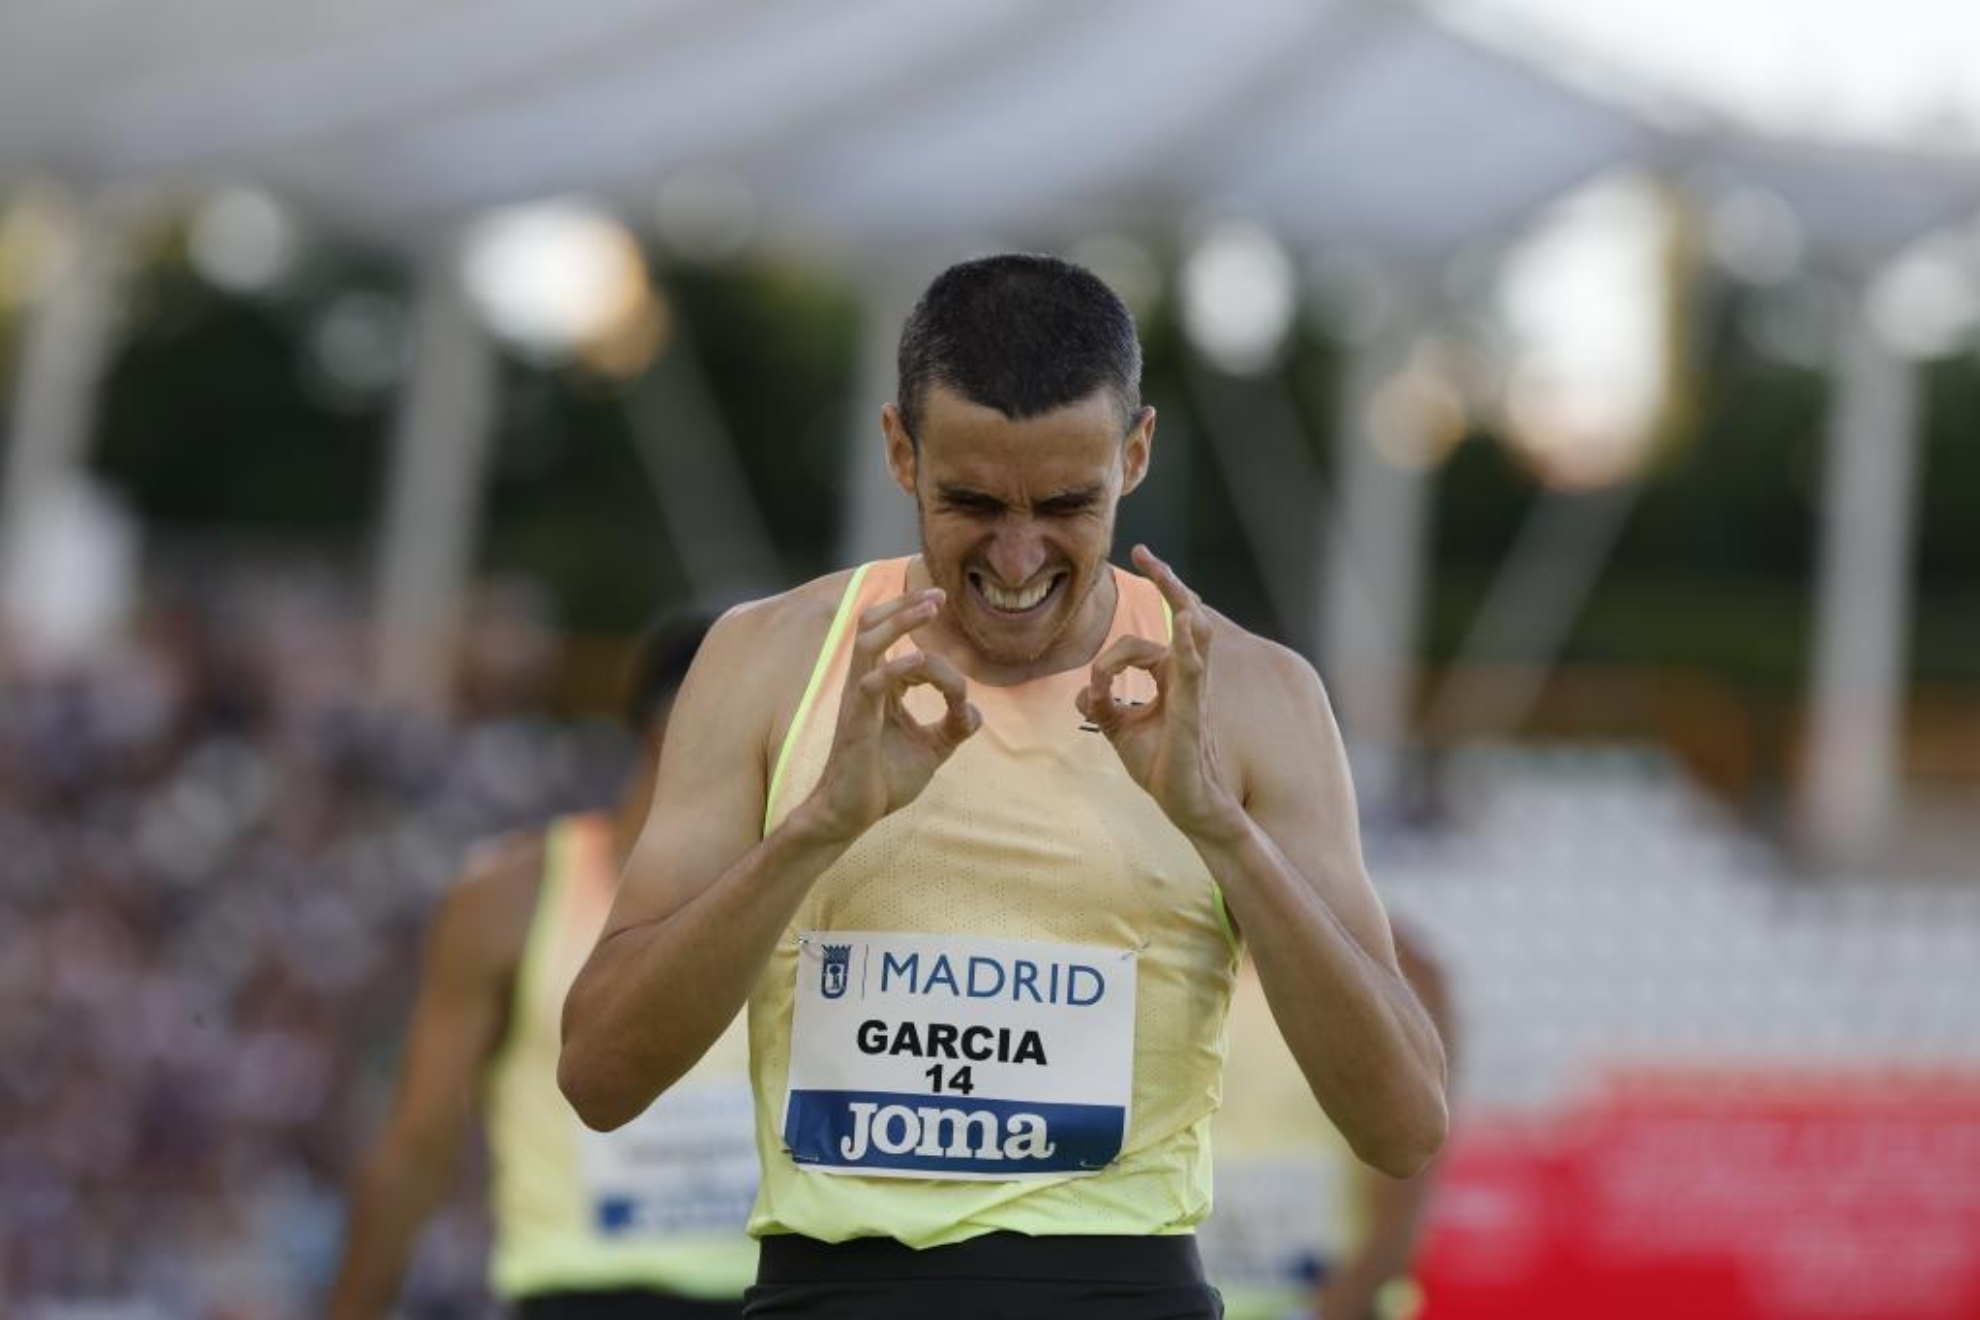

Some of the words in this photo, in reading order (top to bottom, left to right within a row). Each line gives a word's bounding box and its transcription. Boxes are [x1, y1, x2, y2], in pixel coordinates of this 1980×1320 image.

[881, 952, 1105, 1006] MADRID
[857, 1019, 1047, 1065] GARCIA
[925, 1064, 974, 1095] 14
[840, 1102, 1055, 1161] Joma
